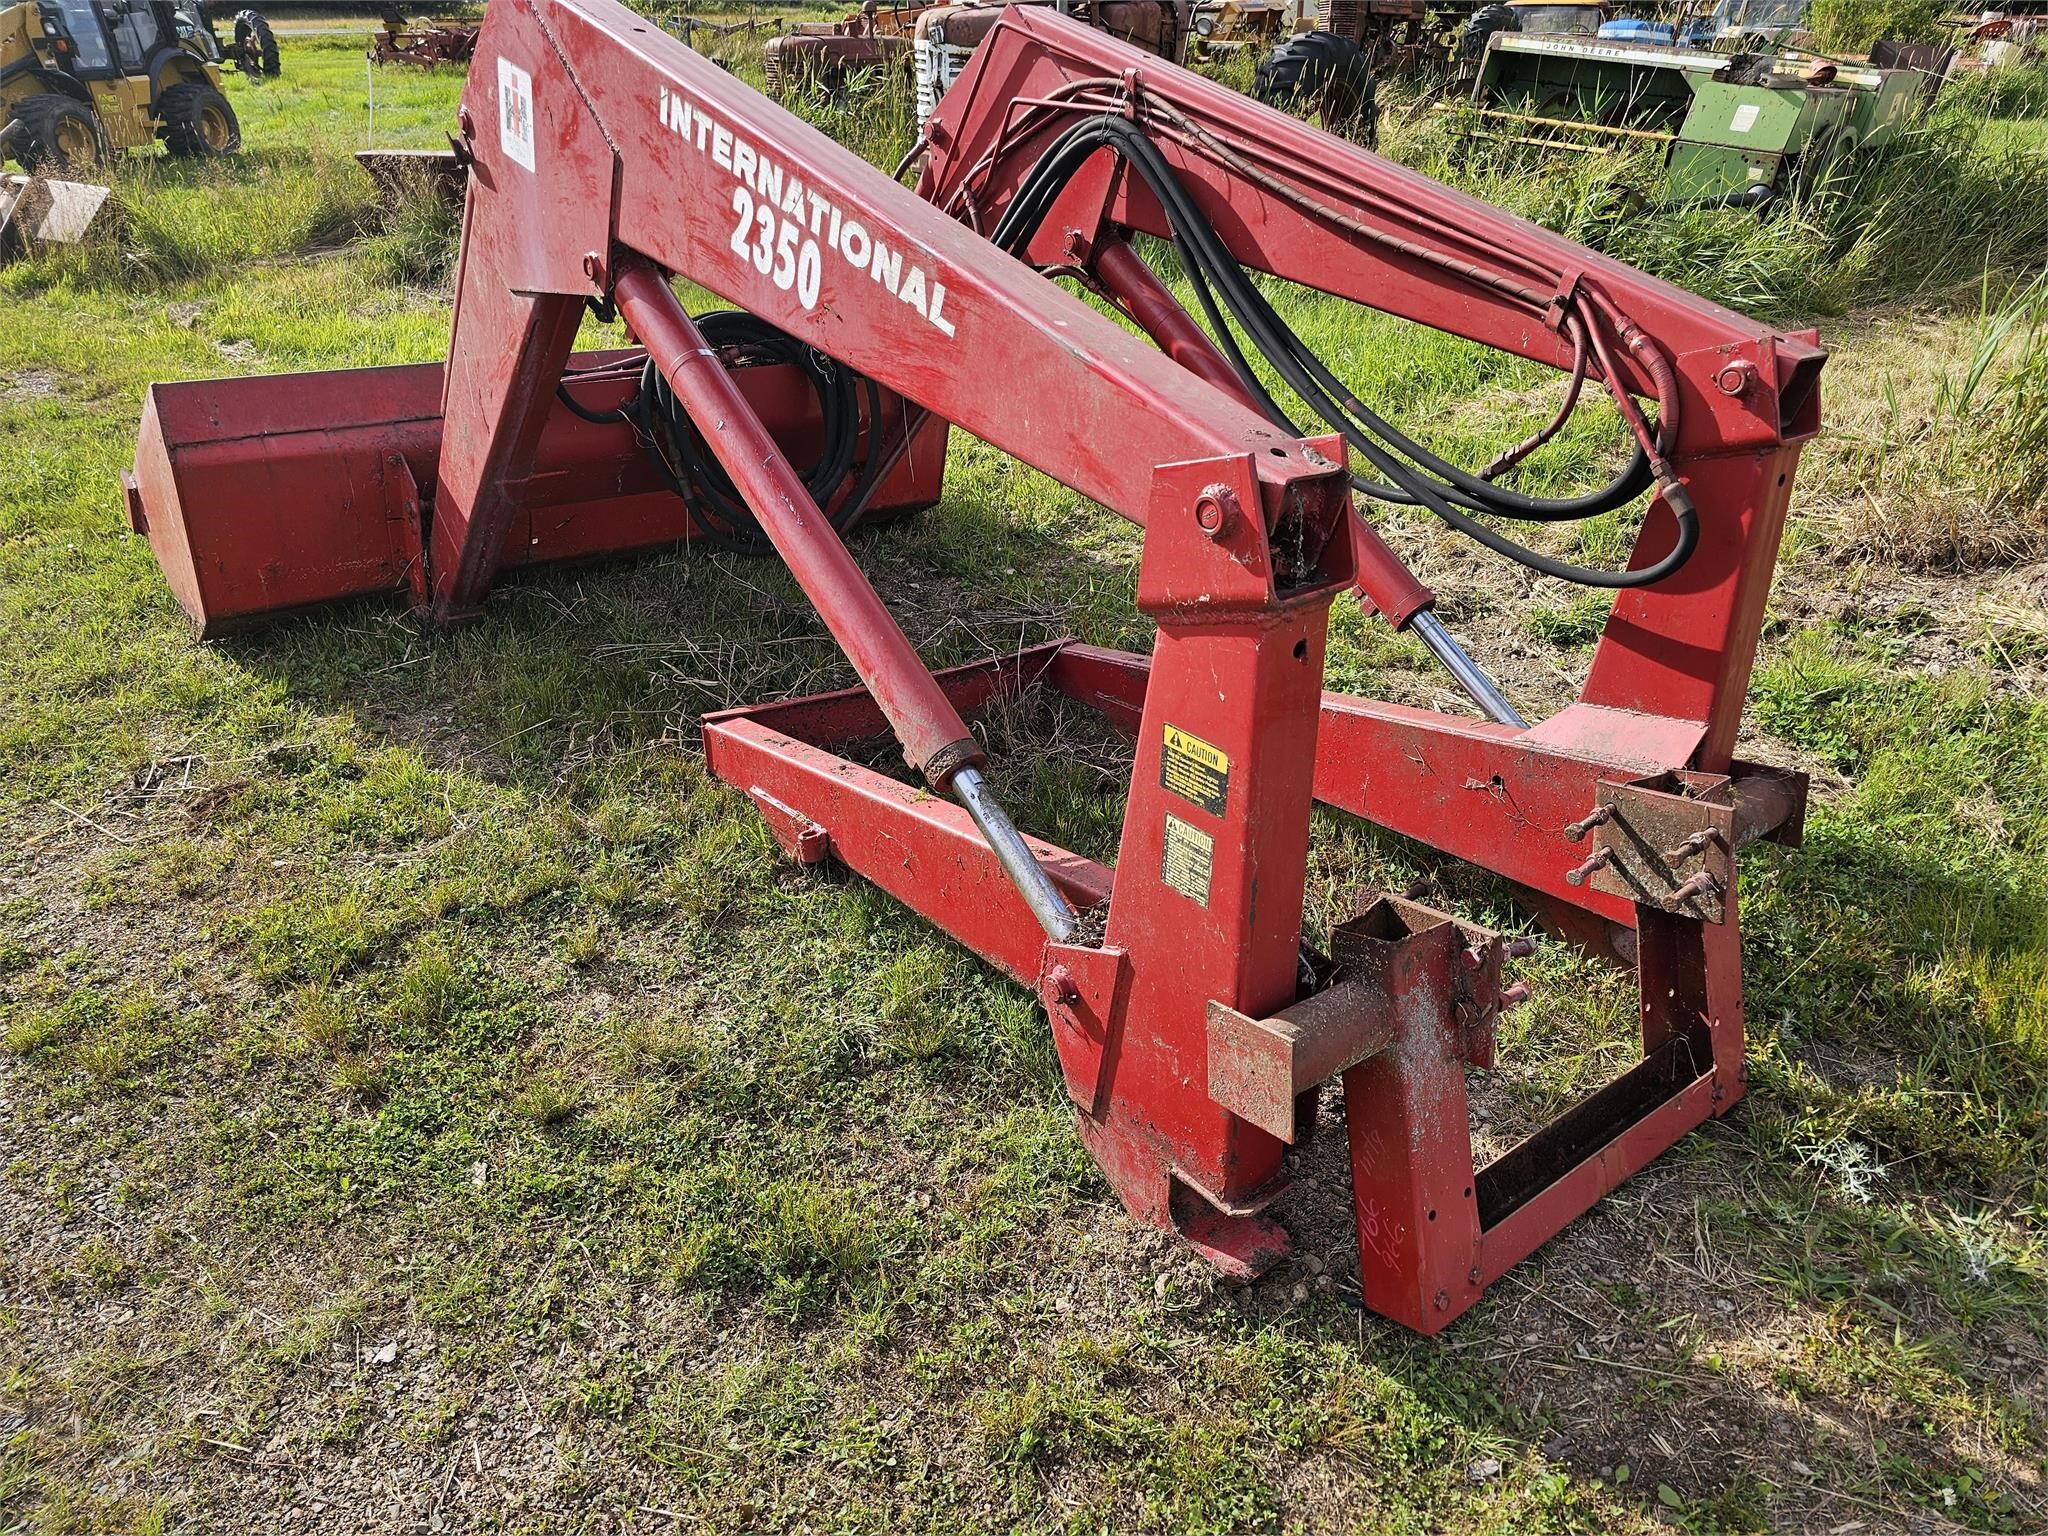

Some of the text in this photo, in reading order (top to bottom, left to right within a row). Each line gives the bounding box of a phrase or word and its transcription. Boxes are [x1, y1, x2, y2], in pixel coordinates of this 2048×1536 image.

[1582, 47, 1620, 56] DEERE
[659, 85, 956, 338] INTERNATIONAL
[730, 187, 822, 310] 2350
[1186, 741, 1220, 767] CAUTION
[1178, 823, 1210, 850] CAUTION
